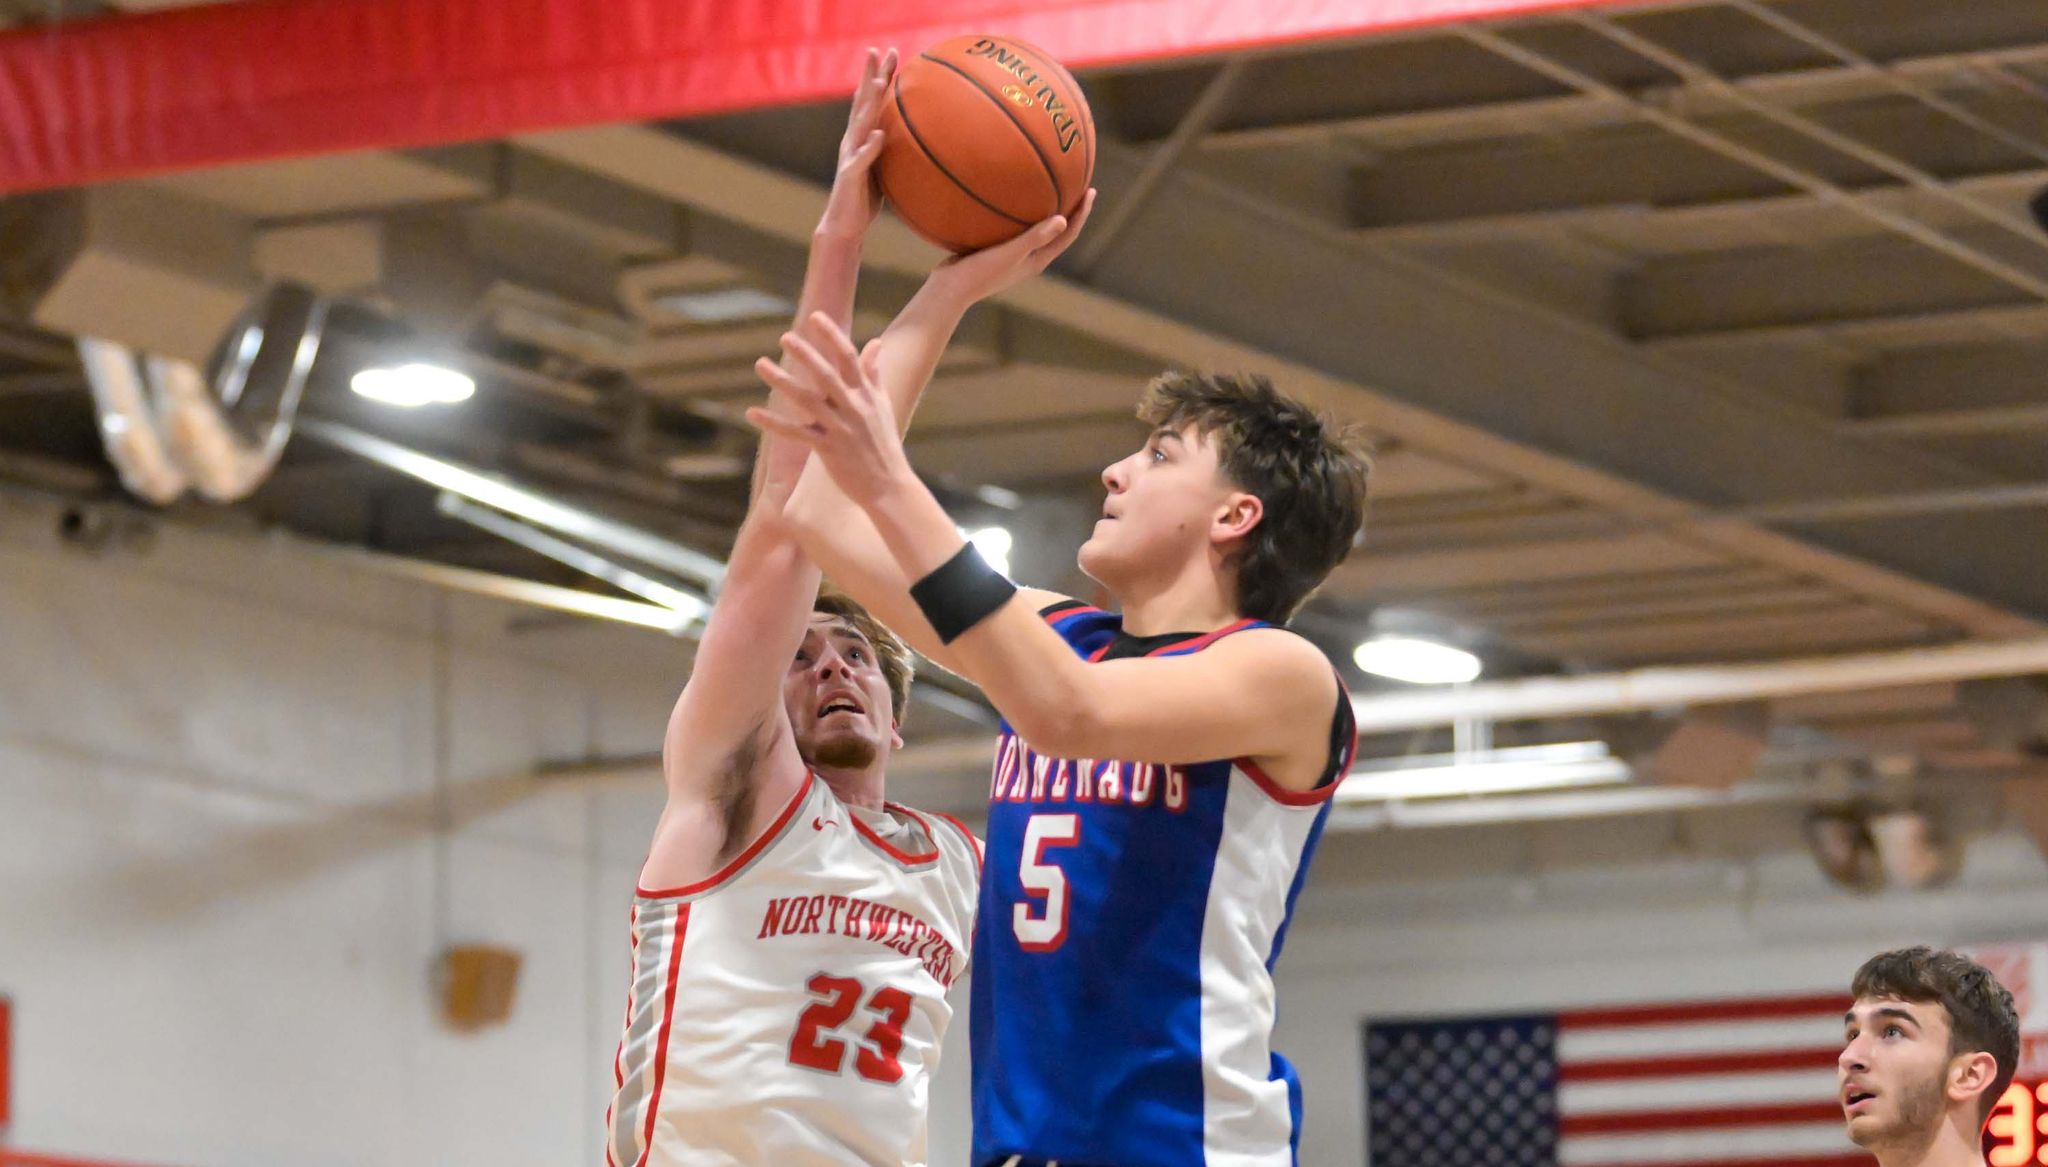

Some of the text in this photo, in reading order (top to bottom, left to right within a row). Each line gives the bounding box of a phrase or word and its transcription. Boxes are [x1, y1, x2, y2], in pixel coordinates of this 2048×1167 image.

[965, 38, 1082, 154] SPALDING
[1012, 813, 1080, 953] 5
[786, 970, 914, 1087] 23
